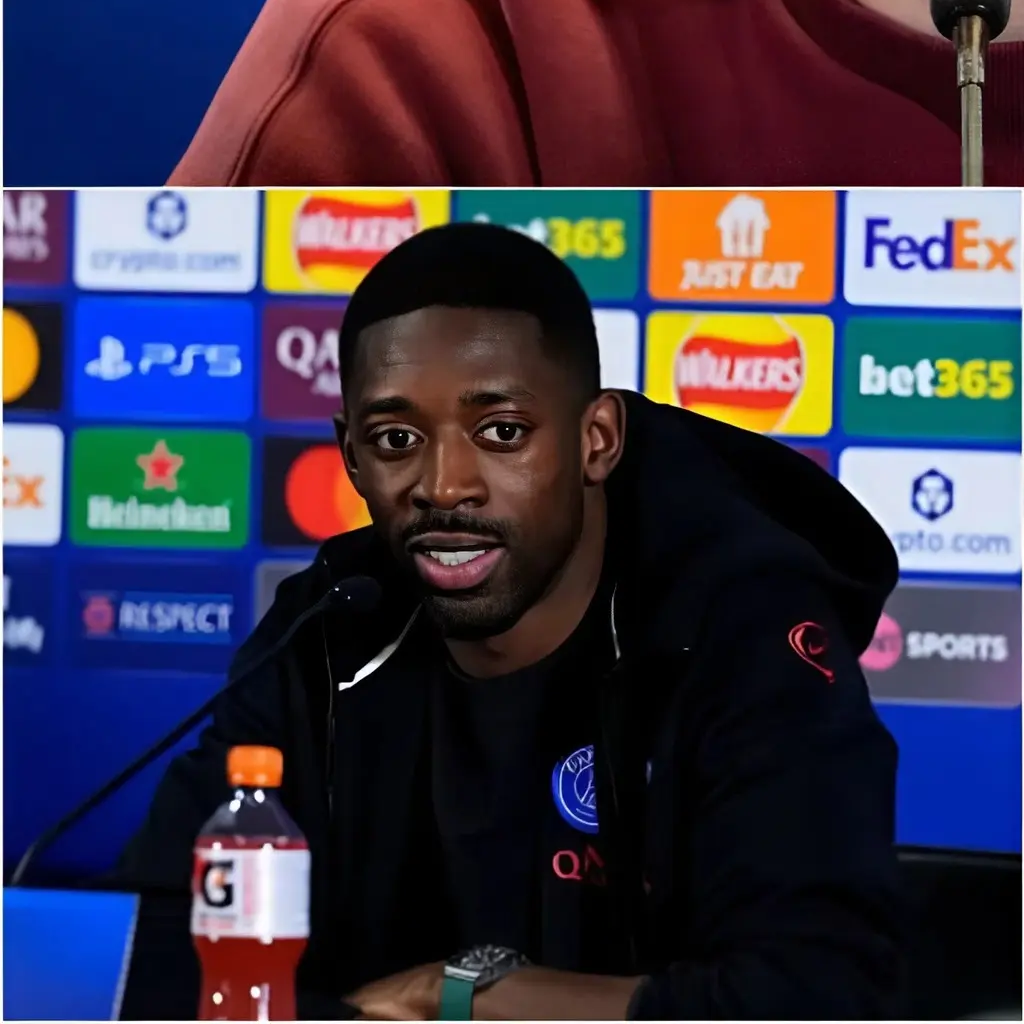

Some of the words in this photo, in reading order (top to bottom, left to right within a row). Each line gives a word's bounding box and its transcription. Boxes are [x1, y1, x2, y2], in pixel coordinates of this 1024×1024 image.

[864, 216, 1016, 272] FedEx
[679, 259, 746, 290] JUST
[750, 262, 804, 289] EAT
[138, 343, 242, 377] PS5
[677, 348, 801, 394] WALKERS
[858, 353, 1015, 400] bet365
[87, 494, 231, 532] Heineken
[118, 600, 233, 634] RESPECT
[906, 631, 1009, 662] SPORTS
[202, 859, 235, 908] G
